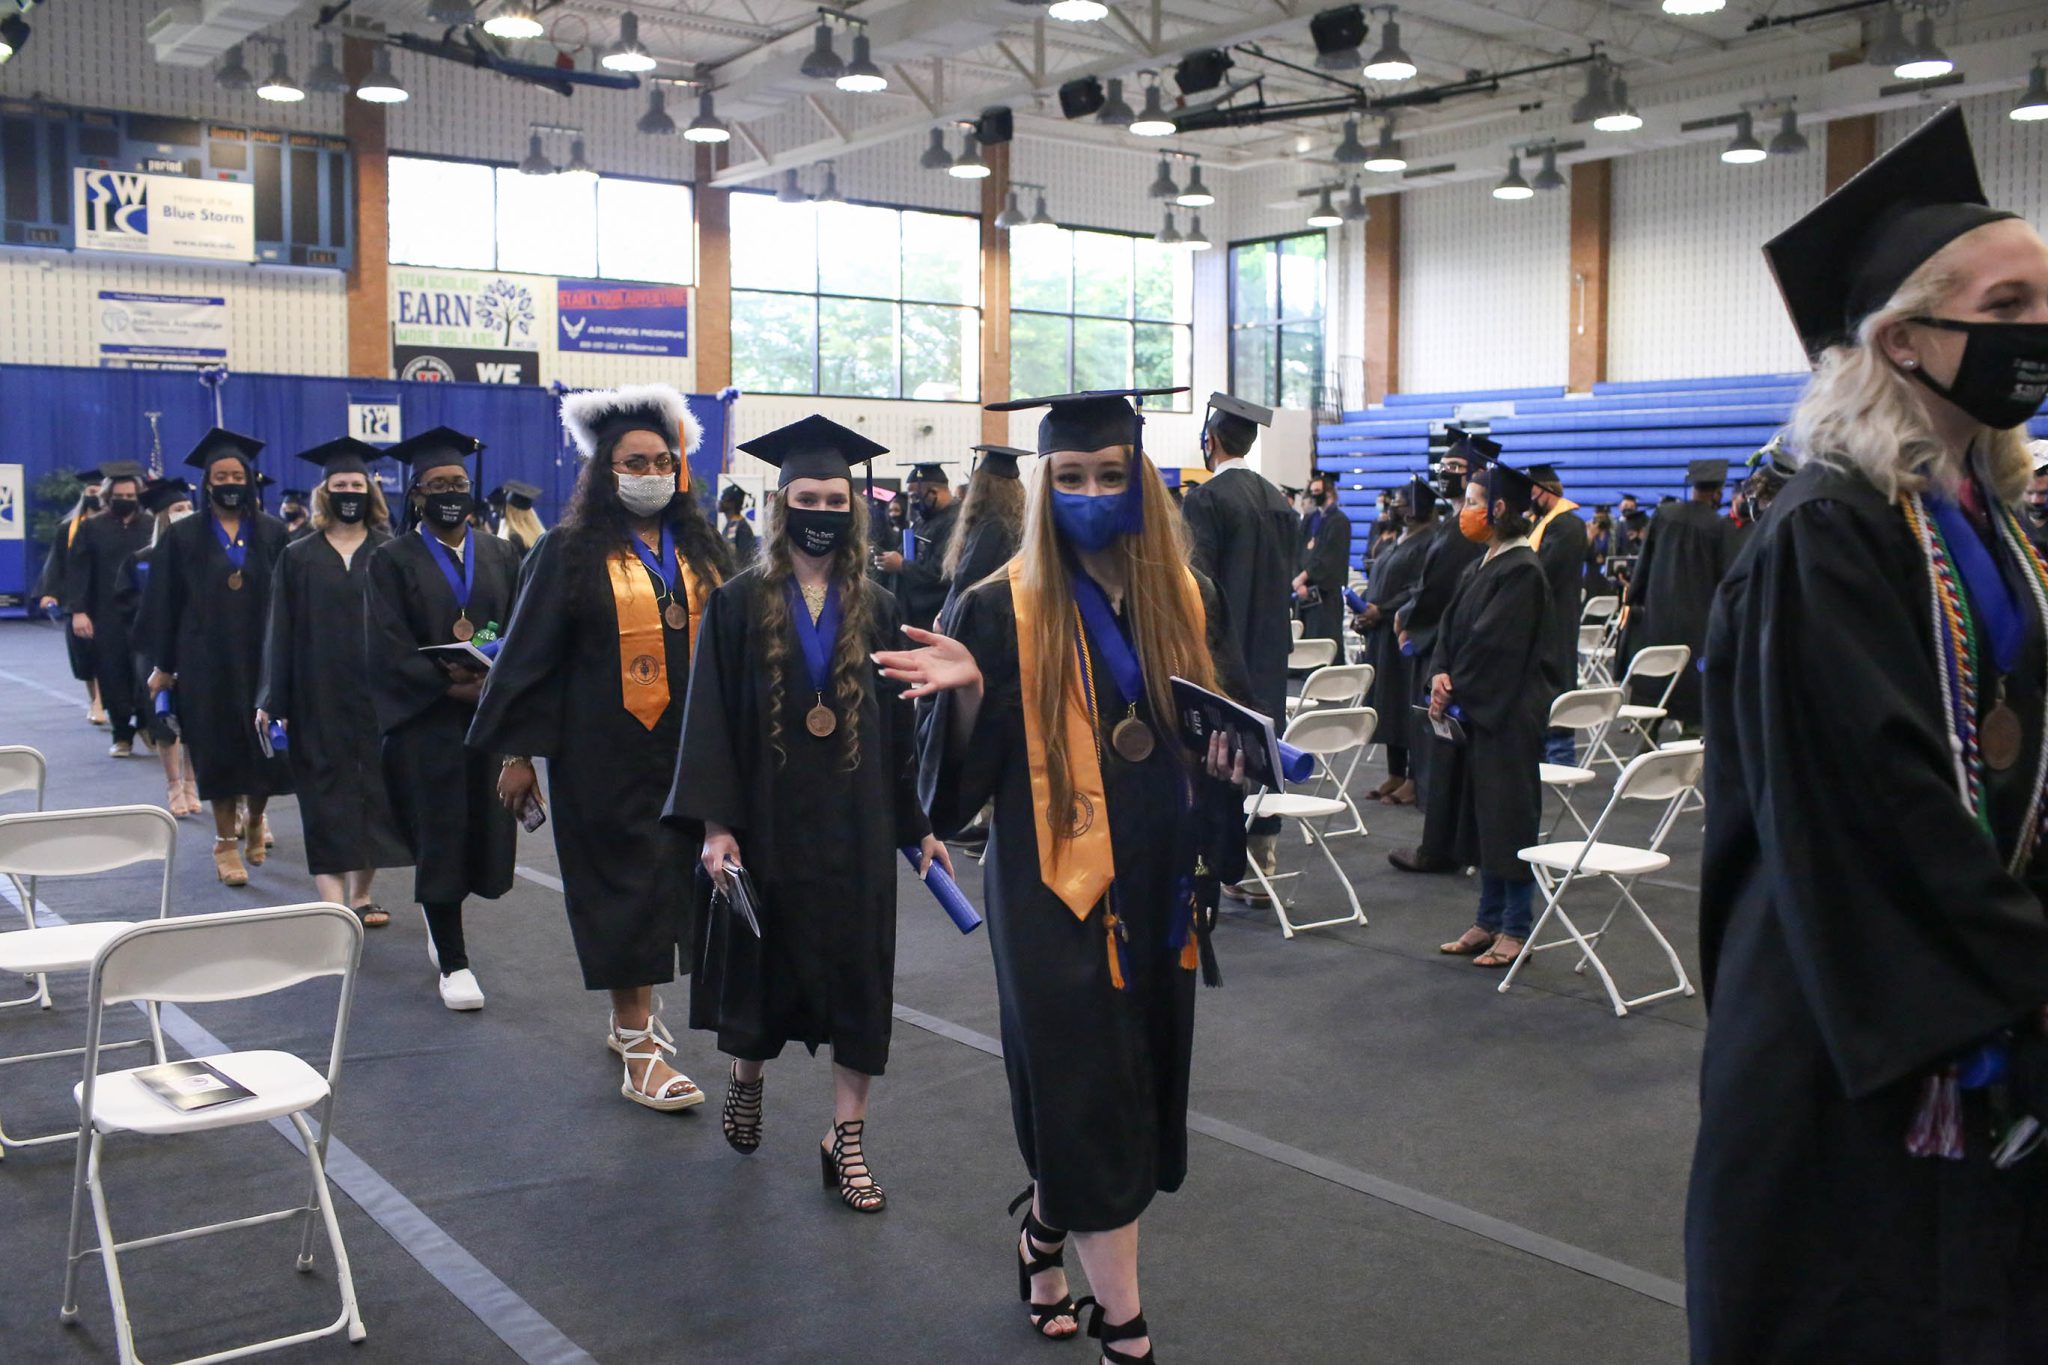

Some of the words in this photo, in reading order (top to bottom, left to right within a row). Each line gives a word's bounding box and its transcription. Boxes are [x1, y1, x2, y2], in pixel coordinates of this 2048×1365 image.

[163, 205, 196, 220] Blue
[200, 208, 244, 224] Storm
[398, 273, 425, 288] STEM
[398, 291, 472, 327] EARN
[398, 328, 433, 342] MORE
[587, 325, 606, 335] AIR
[606, 326, 639, 337] FORCE
[640, 328, 685, 340] RESERVE
[475, 362, 521, 384] WE
